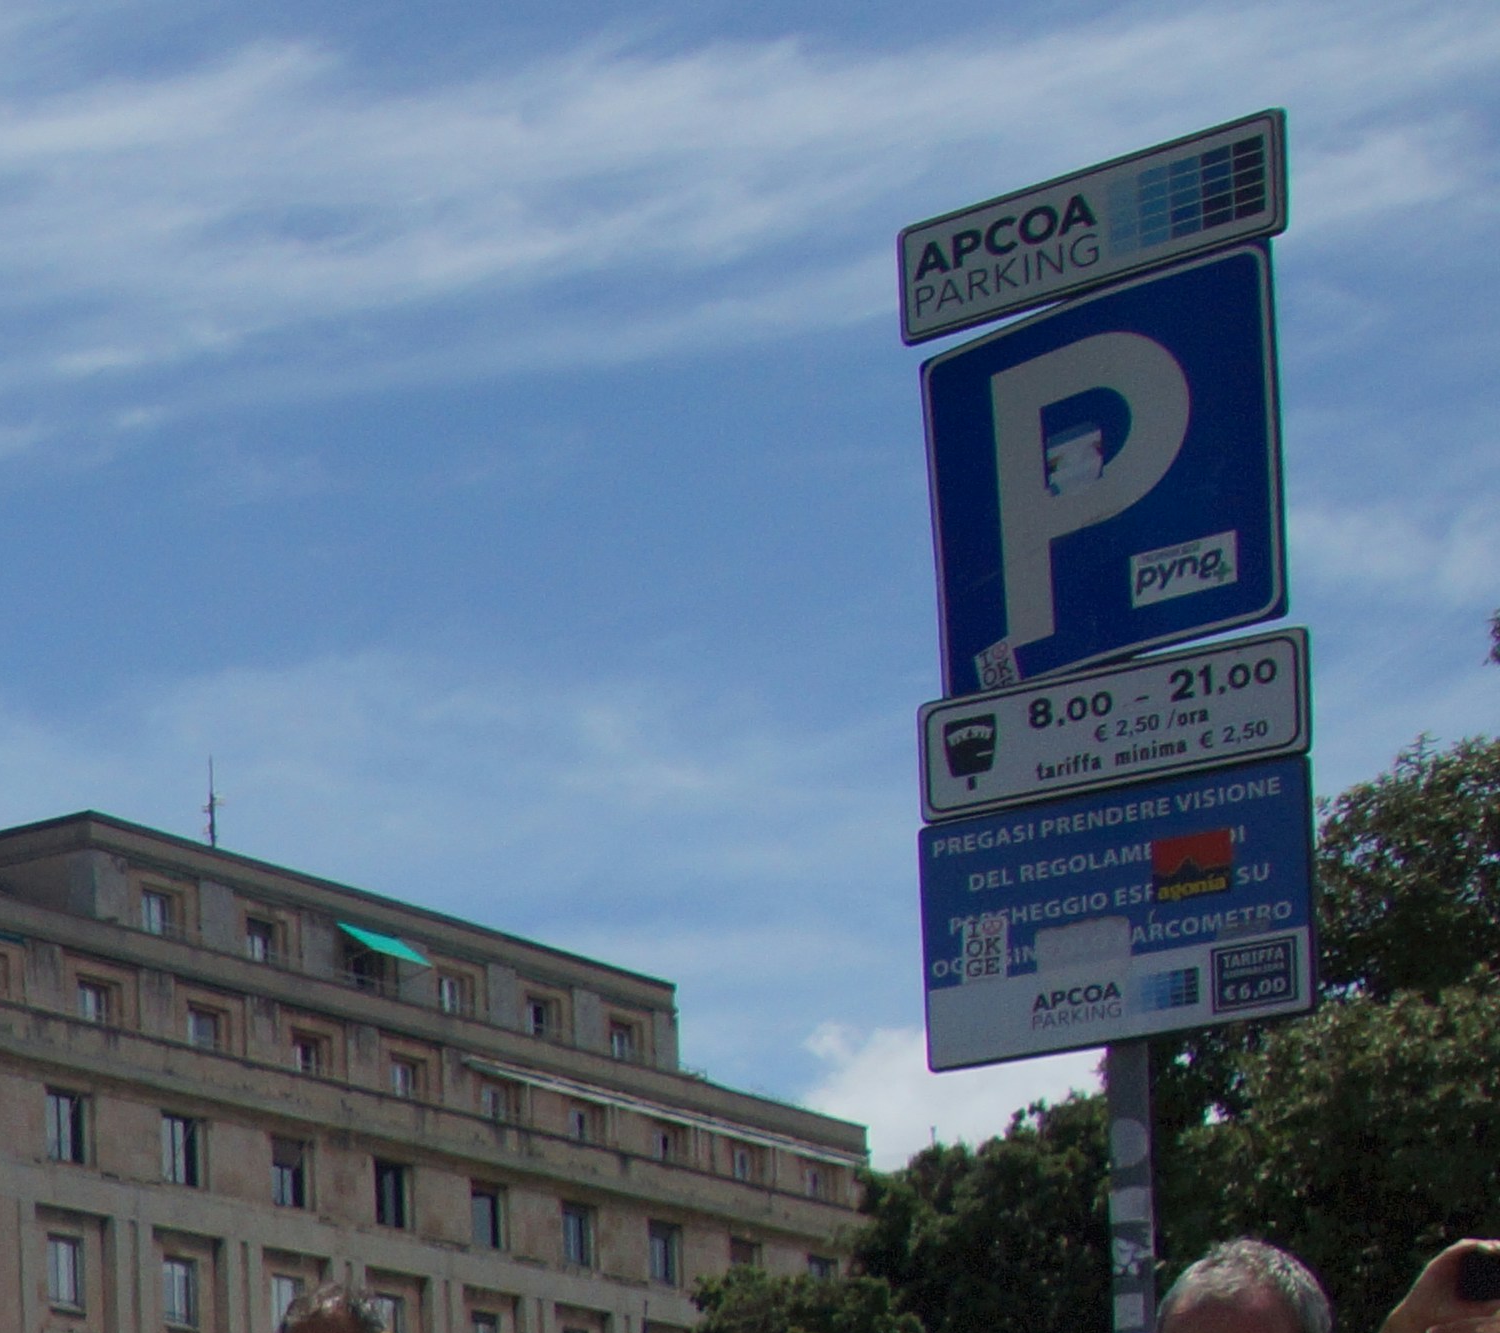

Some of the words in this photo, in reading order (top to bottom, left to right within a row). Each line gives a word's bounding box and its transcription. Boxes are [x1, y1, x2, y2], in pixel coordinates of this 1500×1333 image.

[913, 193, 1098, 281] APCOA
[913, 233, 1100, 318] PARKING
[990, 330, 1190, 664] P
[1028, 691, 1113, 729] 8.00
[1169, 657, 1278, 702] 21.00
[1035, 753, 1102, 781] tariffa
[1114, 738, 1188, 766] minima
[1199, 730, 1215, 749] €
[1094, 724, 1109, 742] €
[932, 820, 1035, 858] PREGASI
[1041, 795, 1169, 839] PRENDERE
[1176, 774, 1282, 814] VISIONE
[968, 866, 1014, 892] DEL
[1020, 842, 1152, 882] REGOLAME
[949, 890, 1109, 936] PAHEGGIO
[1236, 862, 1270, 886] SU
[1129, 900, 1293, 945] ARCOMETRO
[1031, 1004, 1123, 1031] PARKING
[1032, 982, 1122, 1013] APCOA
